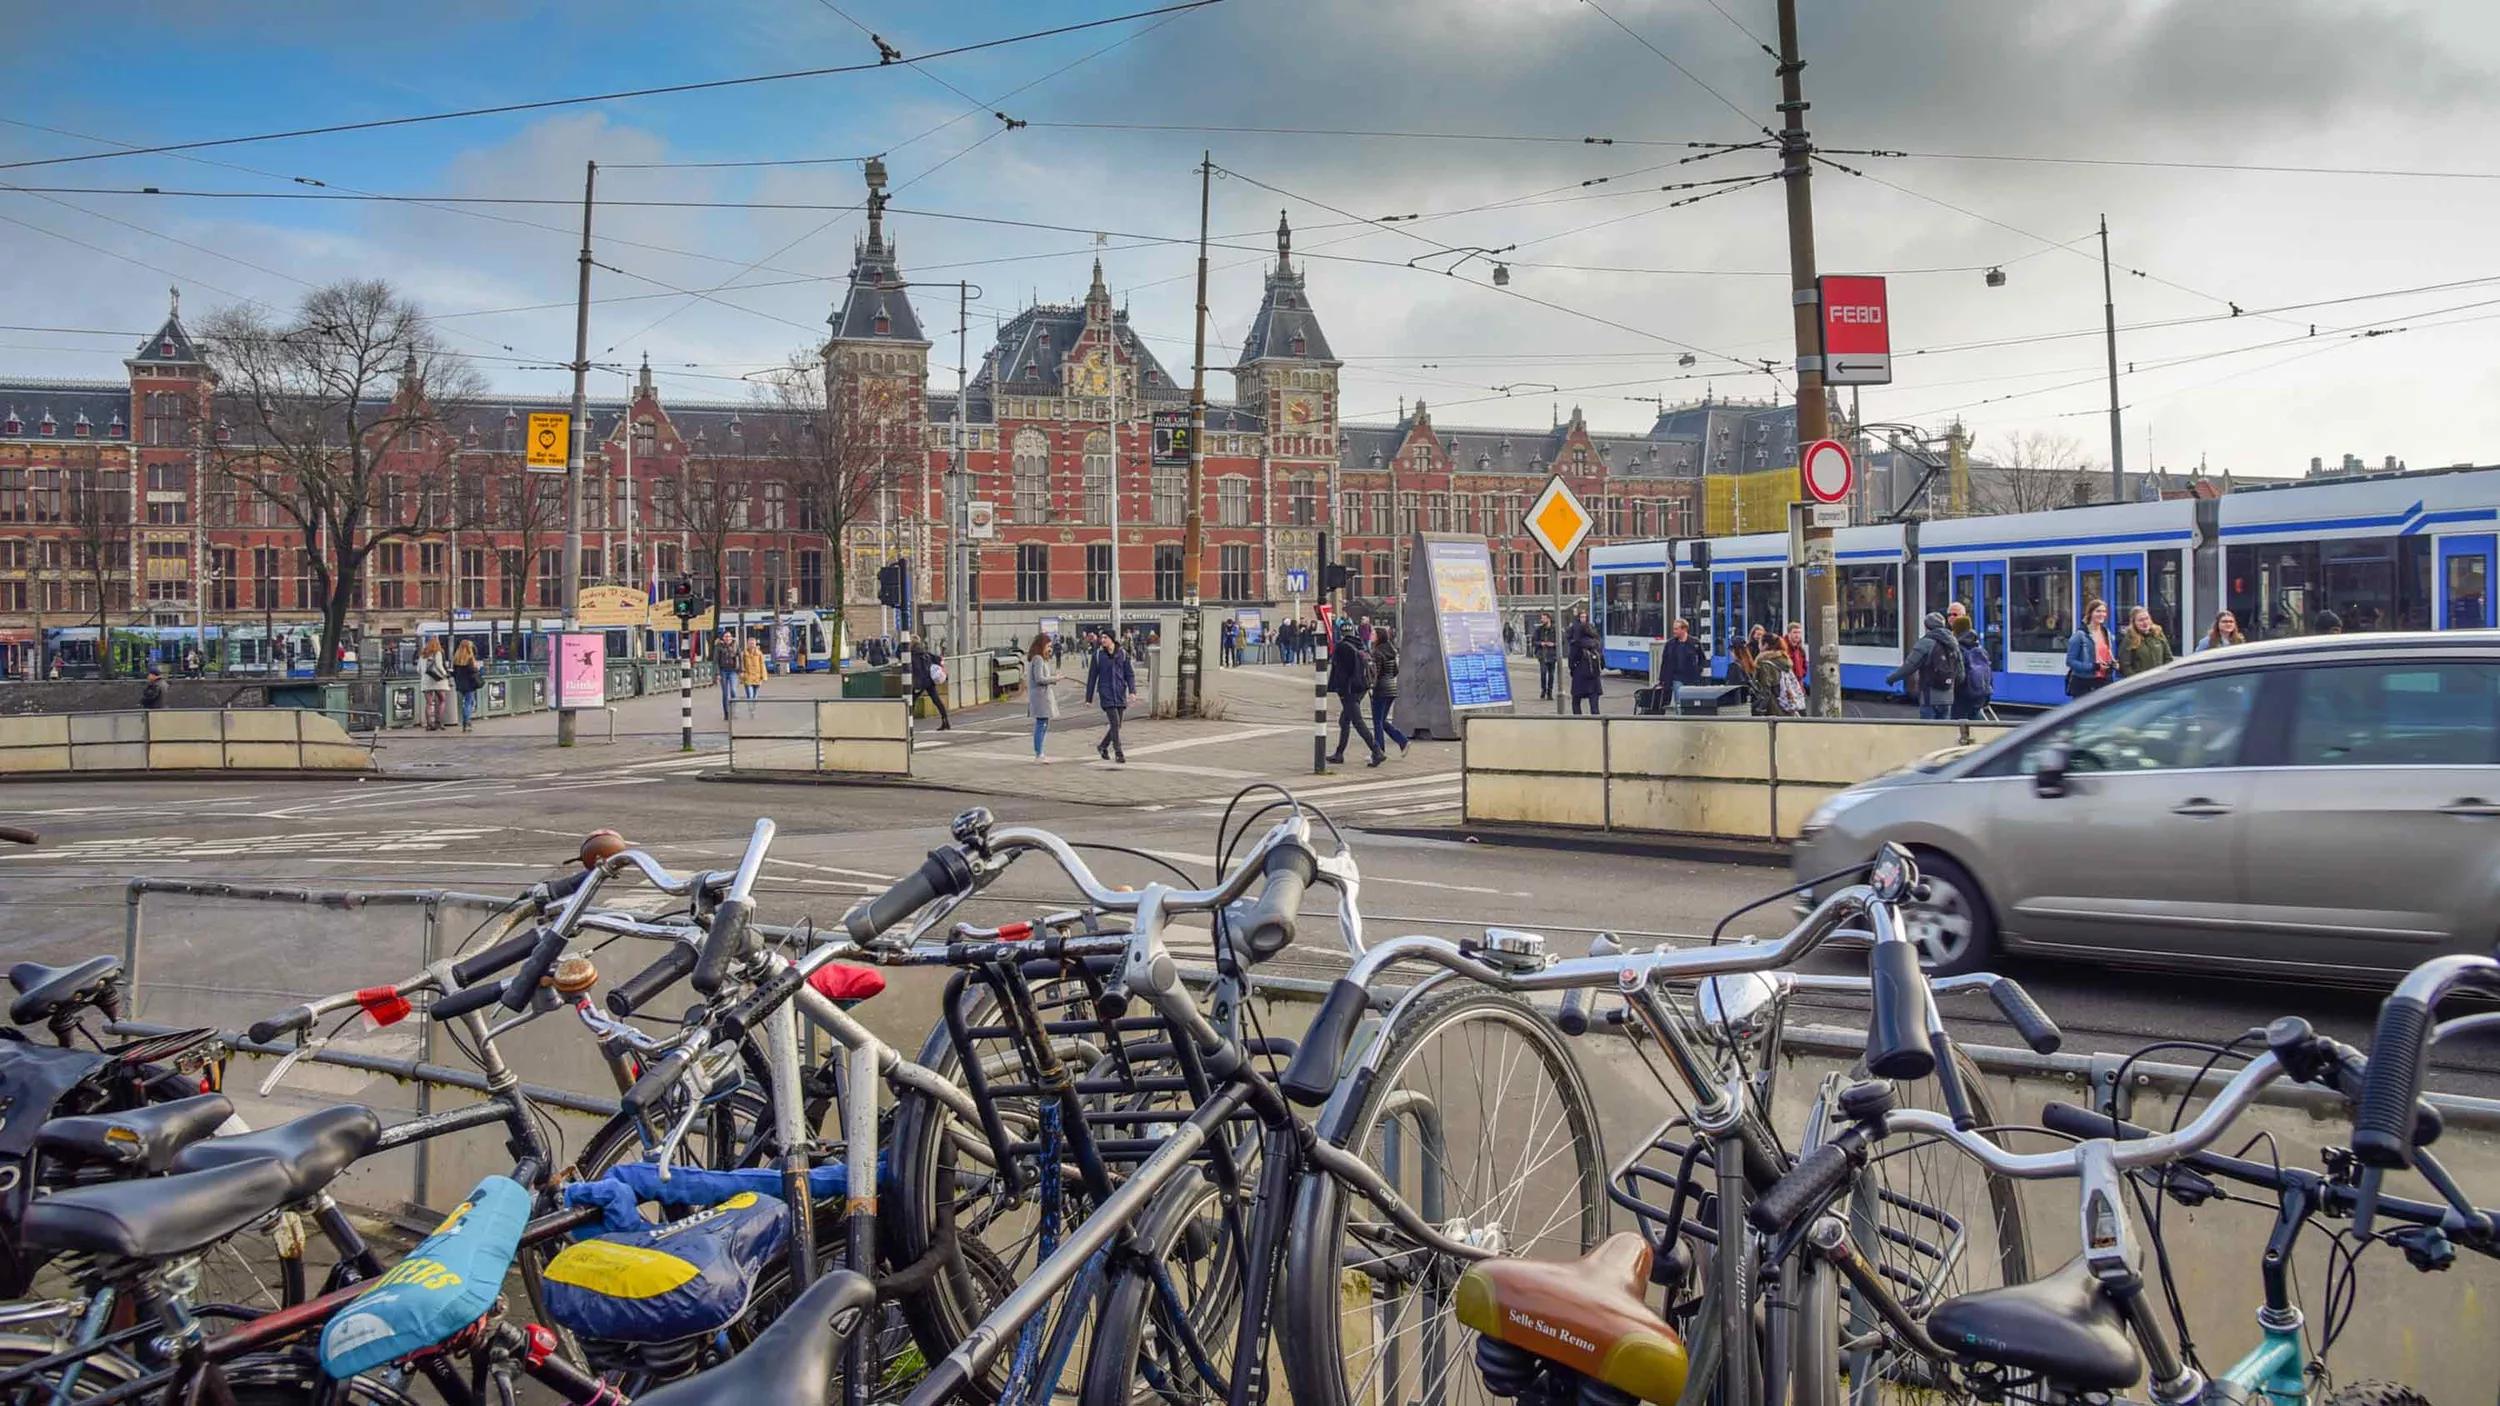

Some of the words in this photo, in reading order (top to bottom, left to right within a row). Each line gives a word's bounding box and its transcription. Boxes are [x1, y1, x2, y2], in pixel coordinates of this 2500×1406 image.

[1830, 306, 1881, 323] FEBO
[1287, 574, 1304, 592] M
[1509, 1308, 1534, 1328] Selle
[1535, 1319, 1557, 1338] San
[1559, 1328, 1595, 1353] Remo
